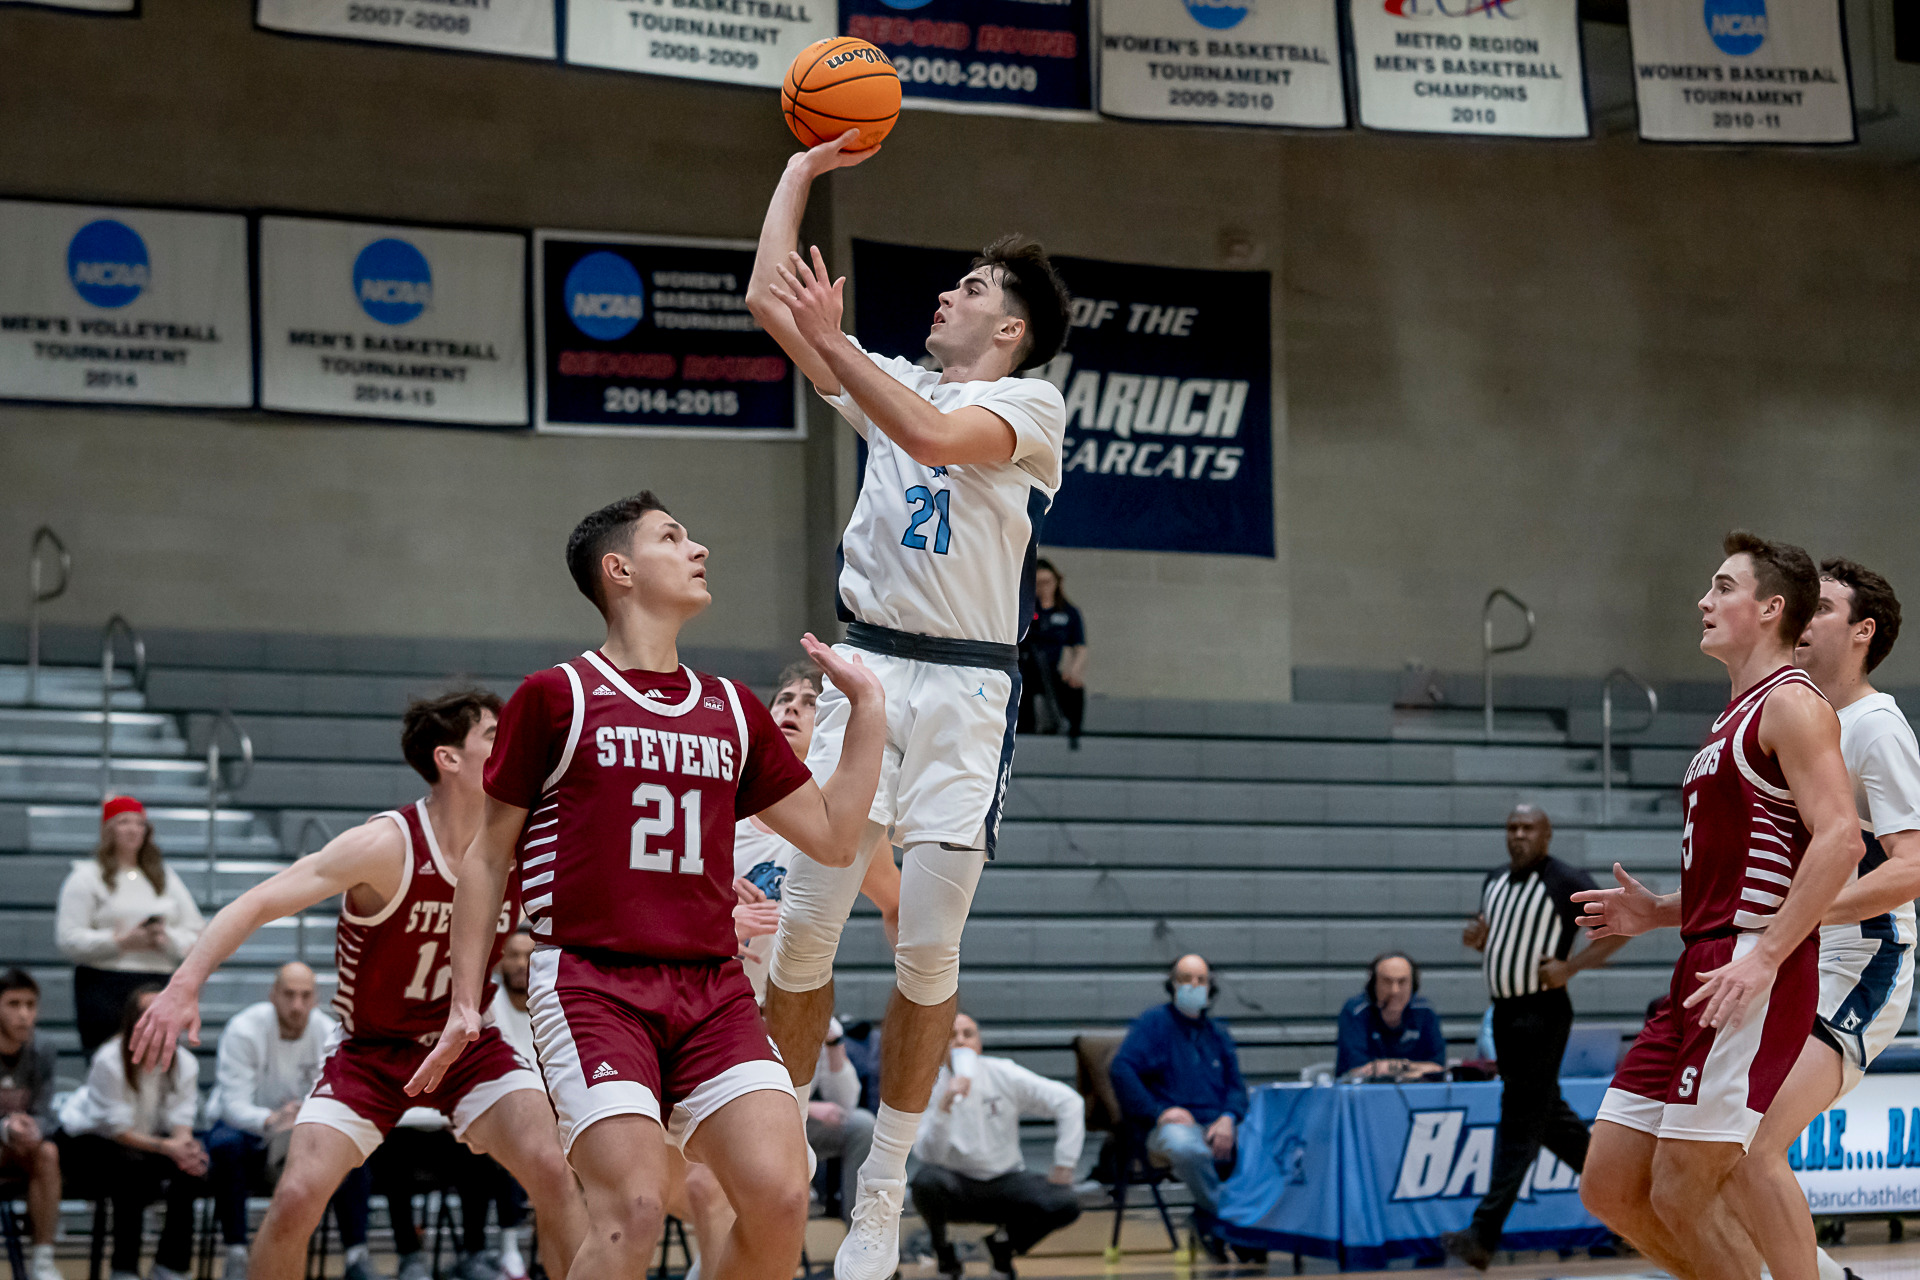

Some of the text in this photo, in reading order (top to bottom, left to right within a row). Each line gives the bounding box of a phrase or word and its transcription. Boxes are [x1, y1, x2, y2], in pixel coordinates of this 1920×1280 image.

[349, 5, 470, 34] 2007-2008
[629, 11, 781, 45] TOURNAMENT
[1712, 14, 1768, 36] NCAA
[650, 41, 758, 70] 2008-2009
[1102, 34, 1199, 56] WOMEN'S
[1395, 31, 1539, 54] METRO REGION
[894, 57, 1038, 92] 2008-2009
[1149, 62, 1293, 86] TOURNAMENT
[1375, 55, 1563, 79] MEN'S BASKETBALL
[1638, 65, 1723, 82] WOMEN'S
[1414, 81, 1528, 102] CHAMPIONS
[1684, 88, 1803, 107] TOURNAMENT
[1452, 107, 1496, 124] 2010
[76, 261, 150, 288] NCAA
[361, 278, 432, 305] NCAA
[573, 292, 645, 319] NCAA
[1071, 297, 1199, 336] OF THE
[34, 341, 188, 366] TOURNAMENT
[288, 329, 499, 361] MEN'S BASKETBALL
[320, 356, 468, 383] TOURNAMENT
[604, 386, 739, 416] 2014-2015
[1024, 353, 1250, 440] ARUCH
[1063, 438, 1245, 481] ARCATS
[901, 485, 951, 555] 21
[705, 700, 723, 710] MAC
[595, 726, 734, 782] STEVENS
[629, 782, 705, 876] 21
[405, 900, 512, 934] STES
[1678, 1066, 1698, 1097] S
